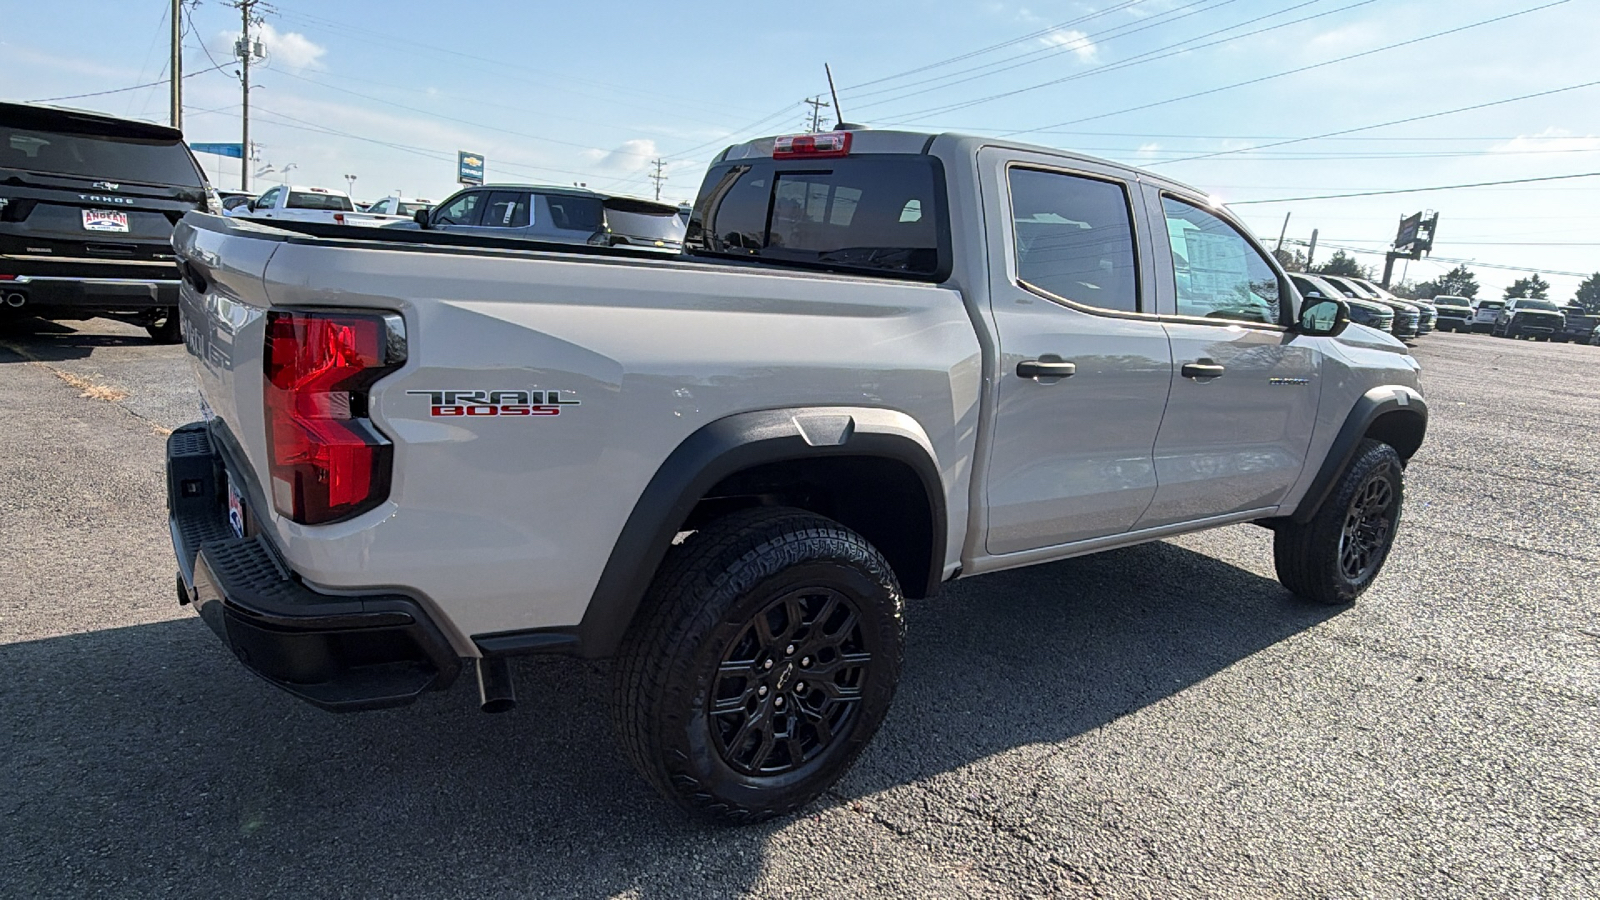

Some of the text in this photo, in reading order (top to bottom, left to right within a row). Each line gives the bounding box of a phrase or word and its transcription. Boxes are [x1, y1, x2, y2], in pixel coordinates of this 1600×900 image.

[78, 194, 134, 204] TAHOE
[406, 390, 580, 405] TRAIL
[430, 404, 560, 417] BOSS
